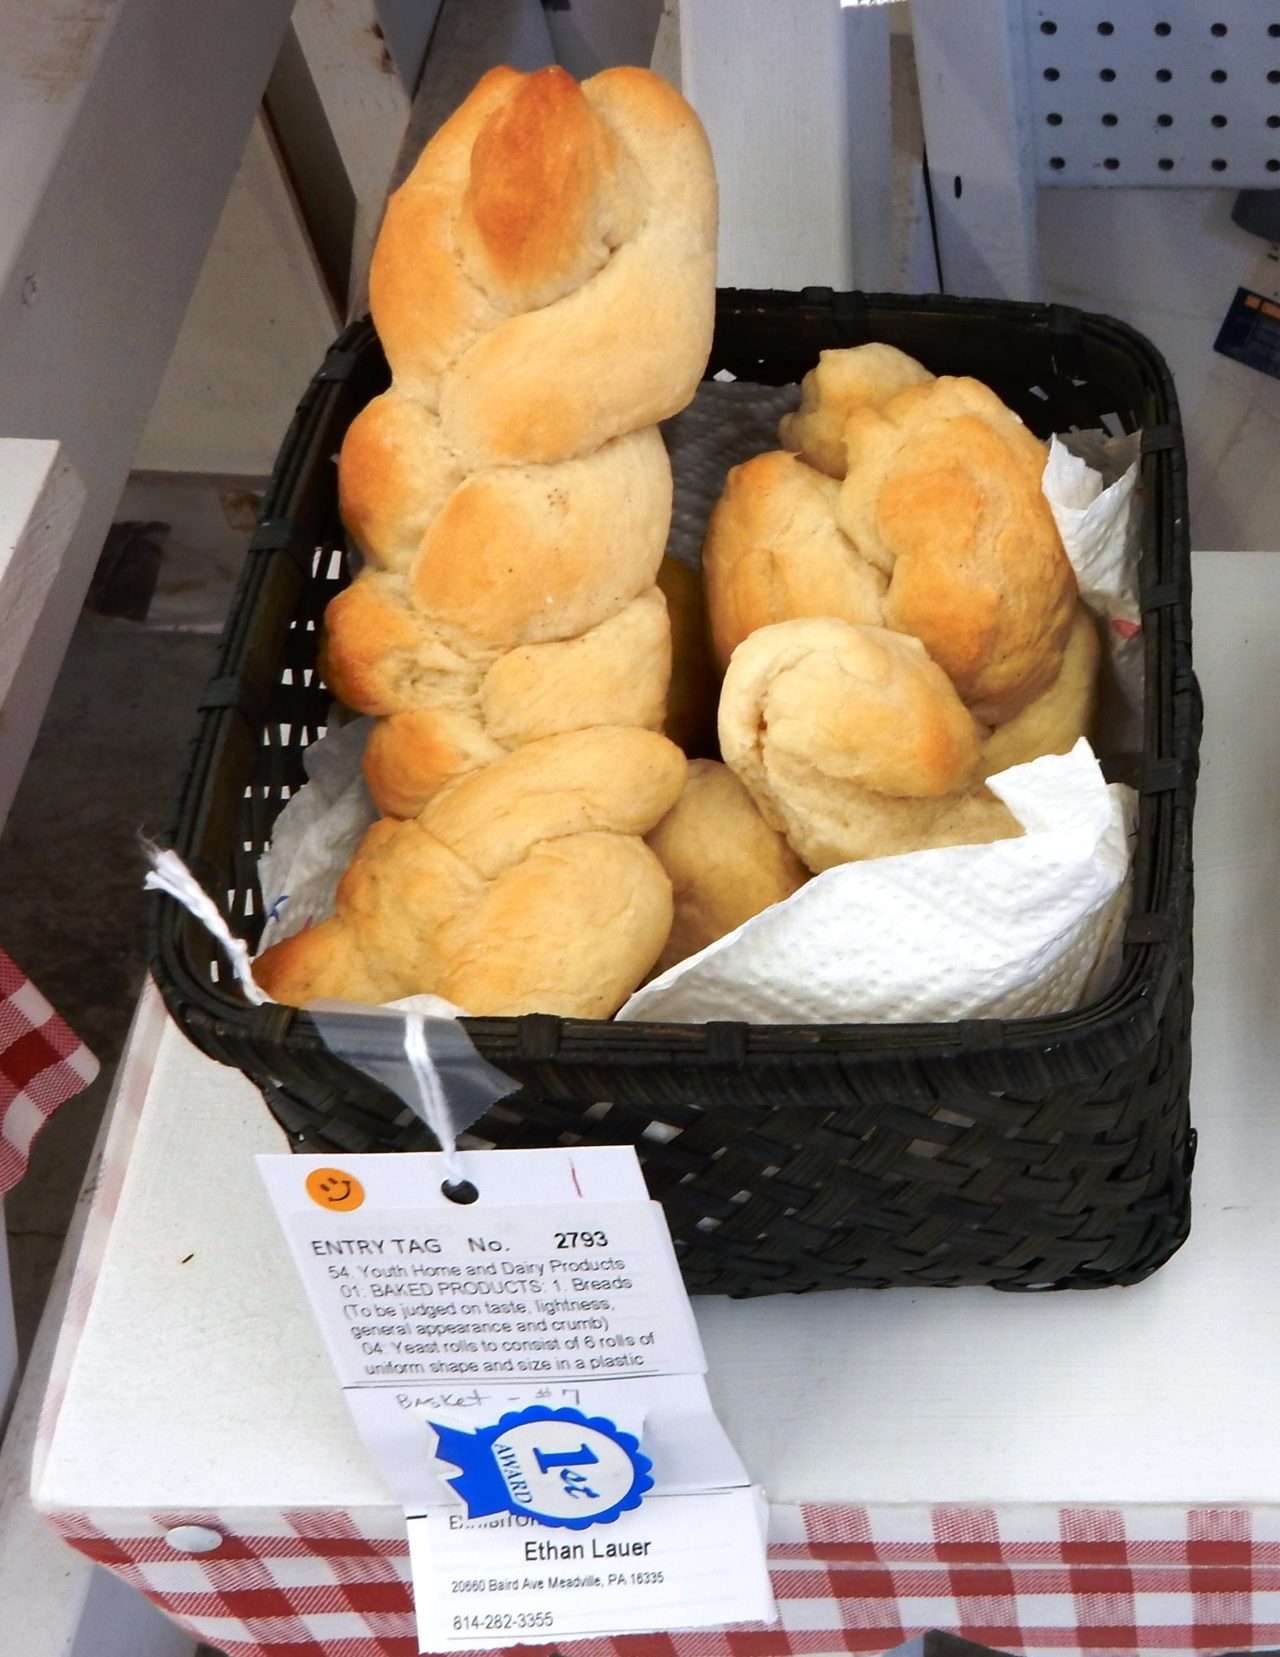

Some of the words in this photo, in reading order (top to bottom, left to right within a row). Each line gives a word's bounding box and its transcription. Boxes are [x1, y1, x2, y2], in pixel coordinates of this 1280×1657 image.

[312, 1240, 384, 1255] ENTRY
[391, 1239, 441, 1254] TAG
[468, 1237, 510, 1252] No.
[554, 1231, 609, 1249] 2793
[358, 1265, 408, 1278] Youth
[411, 1265, 461, 1277] Home
[466, 1262, 497, 1276] and
[501, 1261, 545, 1276] Dairy
[550, 1257, 625, 1273] Products
[370, 1283, 433, 1297] BAKED
[572, 1276, 633, 1291] Breads
[343, 1304, 371, 1320] (To
[375, 1304, 396, 1317] be
[402, 1303, 456, 1319] judged
[461, 1302, 480, 1315] on
[350, 1323, 411, 1340] general
[416, 1320, 512, 1337] appearance
[517, 1318, 547, 1331] and
[551, 1316, 609, 1331] crumb)
[391, 1341, 439, 1354] Yeast
[443, 1340, 478, 1352] rolls
[481, 1338, 498, 1352] to
[502, 1336, 561, 1352] consist
[565, 1336, 580, 1349] of
[599, 1333, 635, 1348] rolls
[639, 1331, 655, 1345] of
[365, 1361, 425, 1375] uniform
[429, 1360, 478, 1376] shape
[484, 1358, 514, 1371] and
[517, 1358, 551, 1371] size
[556, 1358, 570, 1370] in
[575, 1358, 585, 1370] a
[590, 1353, 644, 1370] plastic
[494, 1443, 532, 1503] AWARD
[533, 1443, 600, 1499] 1st
[525, 1541, 584, 1561] Ethan
[592, 1539, 651, 1558] Lauer
[489, 1579, 518, 1591] Baird
[522, 1577, 544, 1589] Ave
[607, 1573, 626, 1585] PA
[453, 1612, 553, 1630] 814-282-3355
